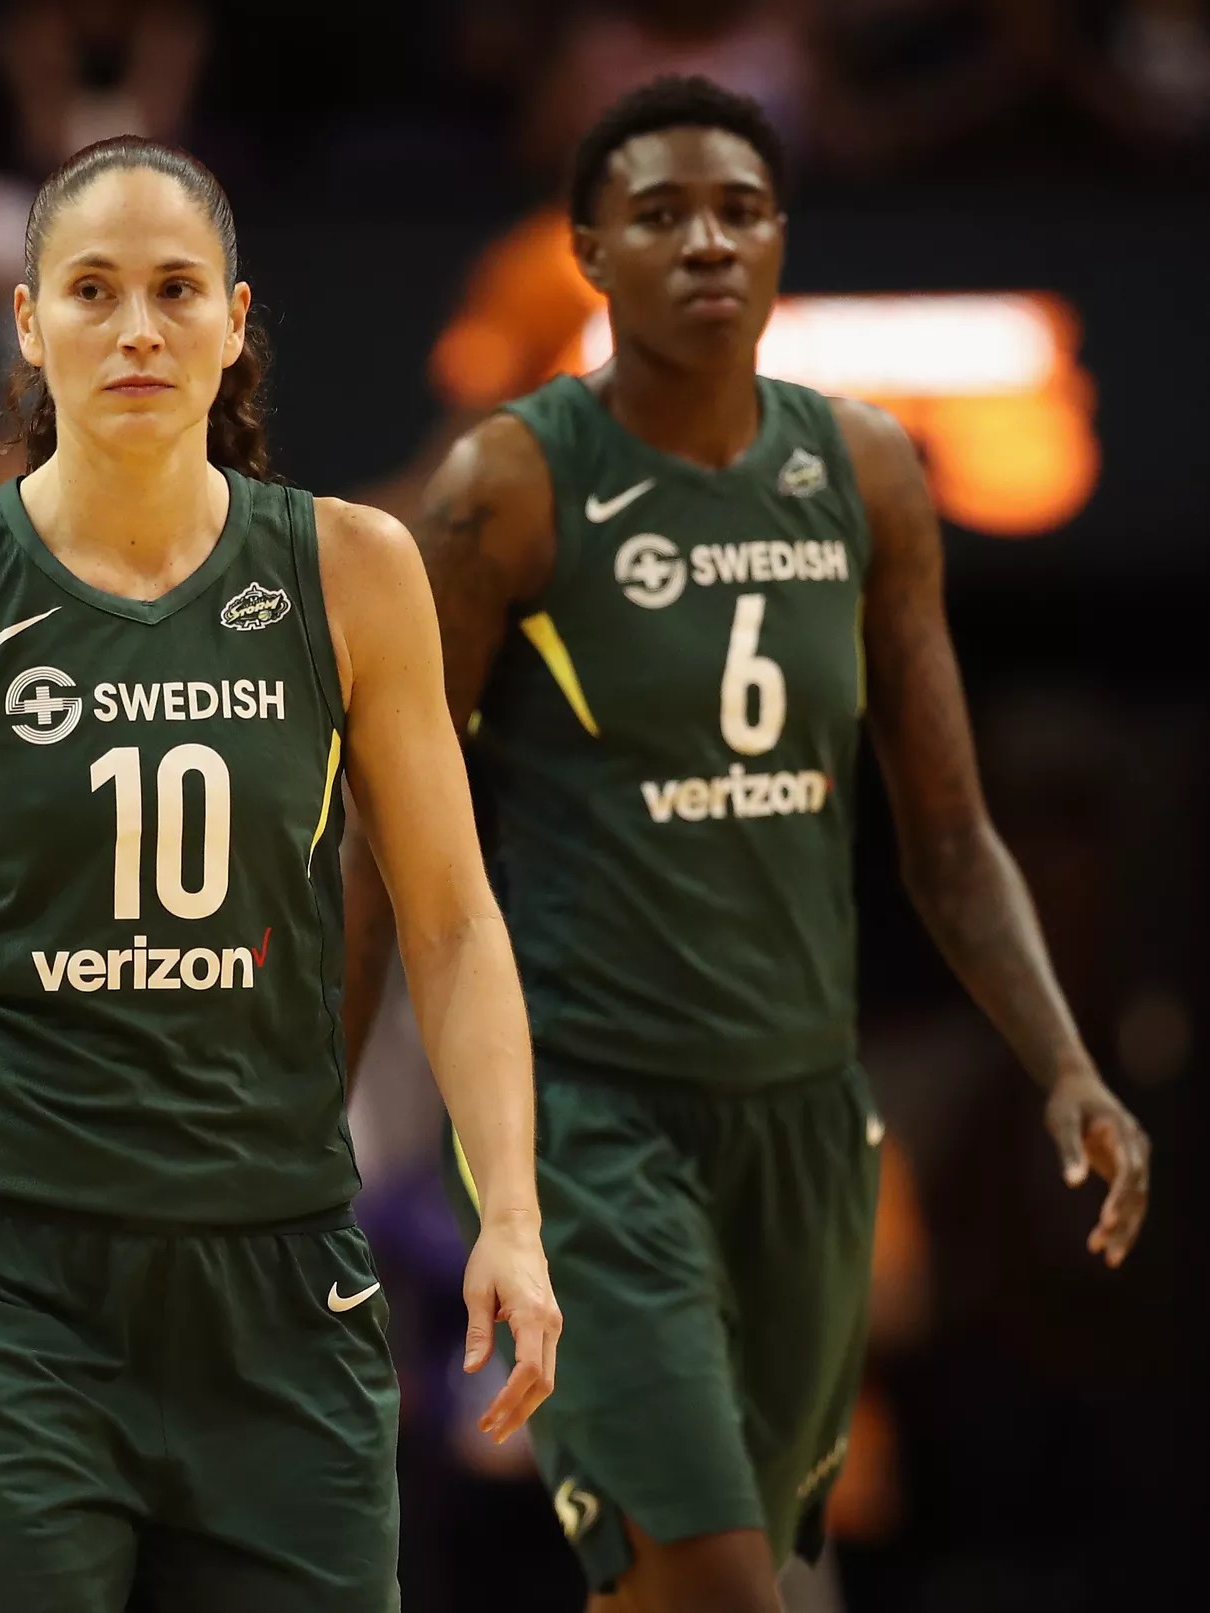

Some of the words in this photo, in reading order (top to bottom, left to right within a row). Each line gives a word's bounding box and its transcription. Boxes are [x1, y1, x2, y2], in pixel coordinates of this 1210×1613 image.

[690, 539, 849, 585] SWEDISH
[93, 678, 285, 722] SWEDISH
[720, 594, 786, 755] 6
[640, 763, 828, 824] verizon
[90, 743, 231, 920] 10
[31, 935, 254, 992] verizon
